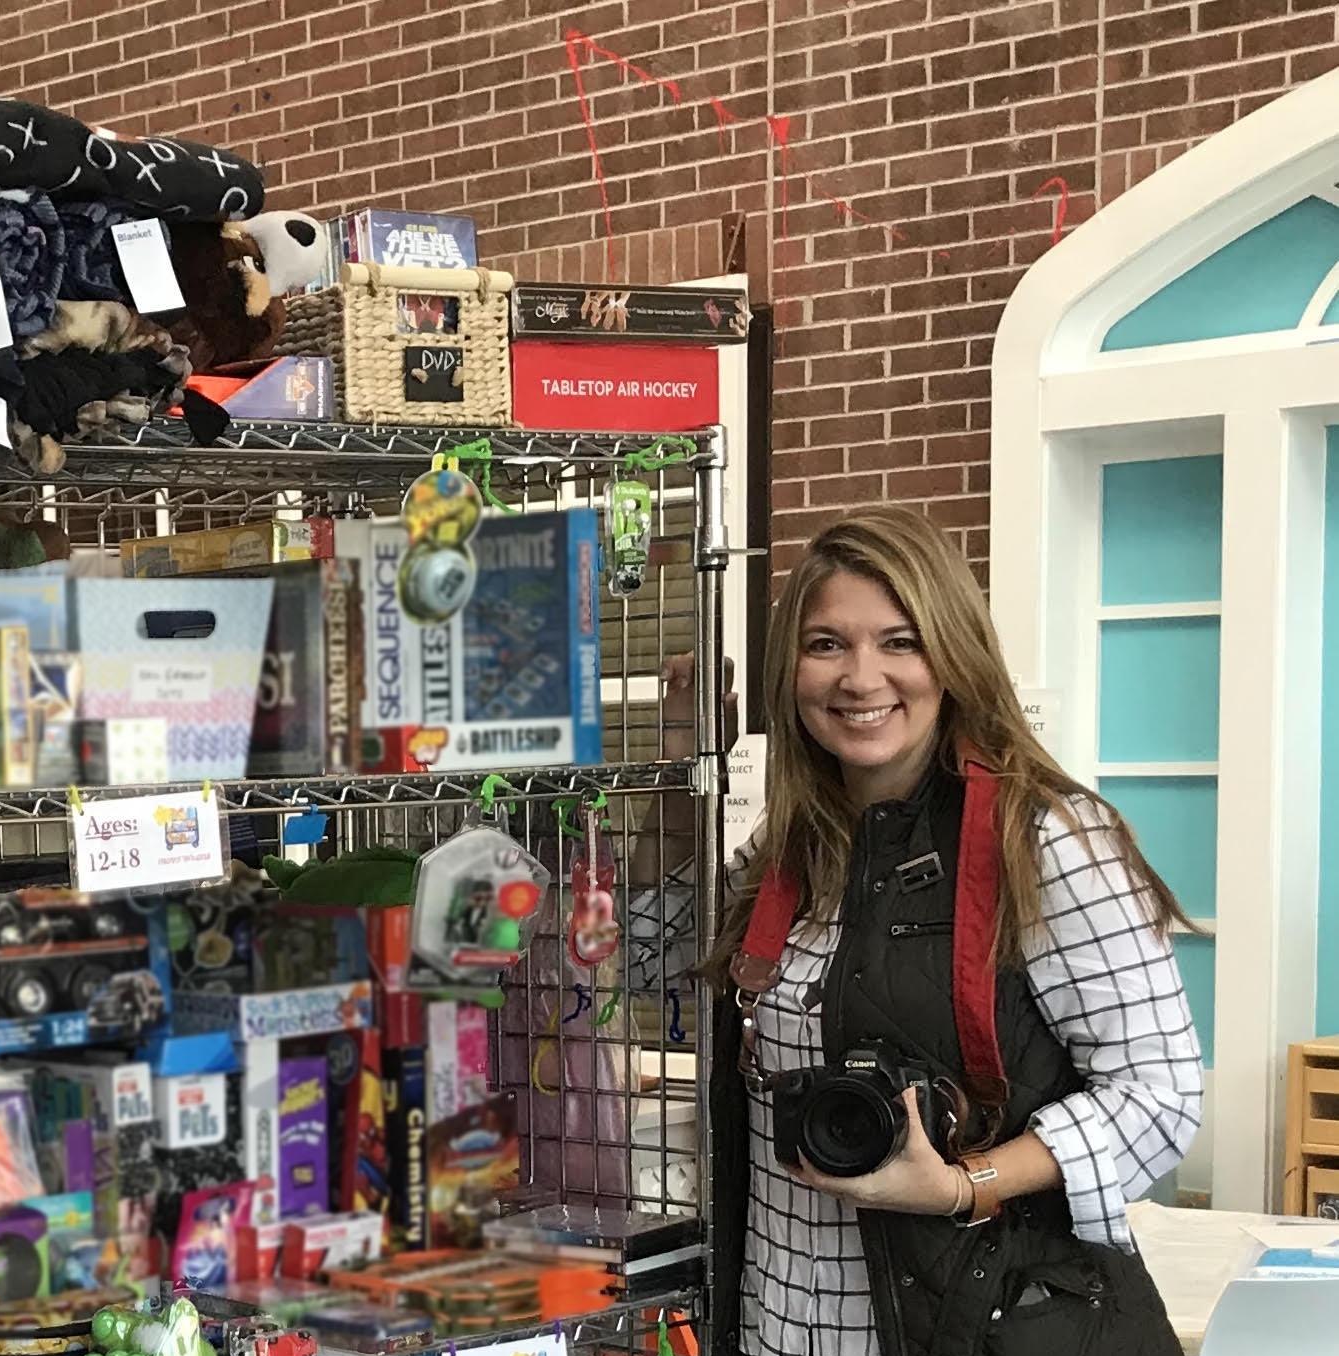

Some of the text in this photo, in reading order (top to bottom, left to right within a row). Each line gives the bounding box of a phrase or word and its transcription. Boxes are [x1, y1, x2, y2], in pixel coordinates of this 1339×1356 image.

[116, 228, 152, 242] Blanket
[385, 229, 456, 245] ARE WE
[386, 238, 462, 254] THERE
[541, 379, 697, 398] TABLETOP AIR HOCKEY
[472, 528, 556, 570] ORTNITE
[375, 545, 402, 720] SEQUENCE
[328, 579, 349, 736] PARCHEESI
[1023, 705, 1041, 714] ACE
[470, 726, 562, 755] BATTLESHIP
[729, 750, 750, 759] LACE
[727, 765, 753, 774] OJECT
[85, 816, 139, 840] Ages:
[90, 848, 141, 872] 12-18
[844, 1060, 876, 1068] Canon
[407, 1109, 424, 1242] Chemistry
